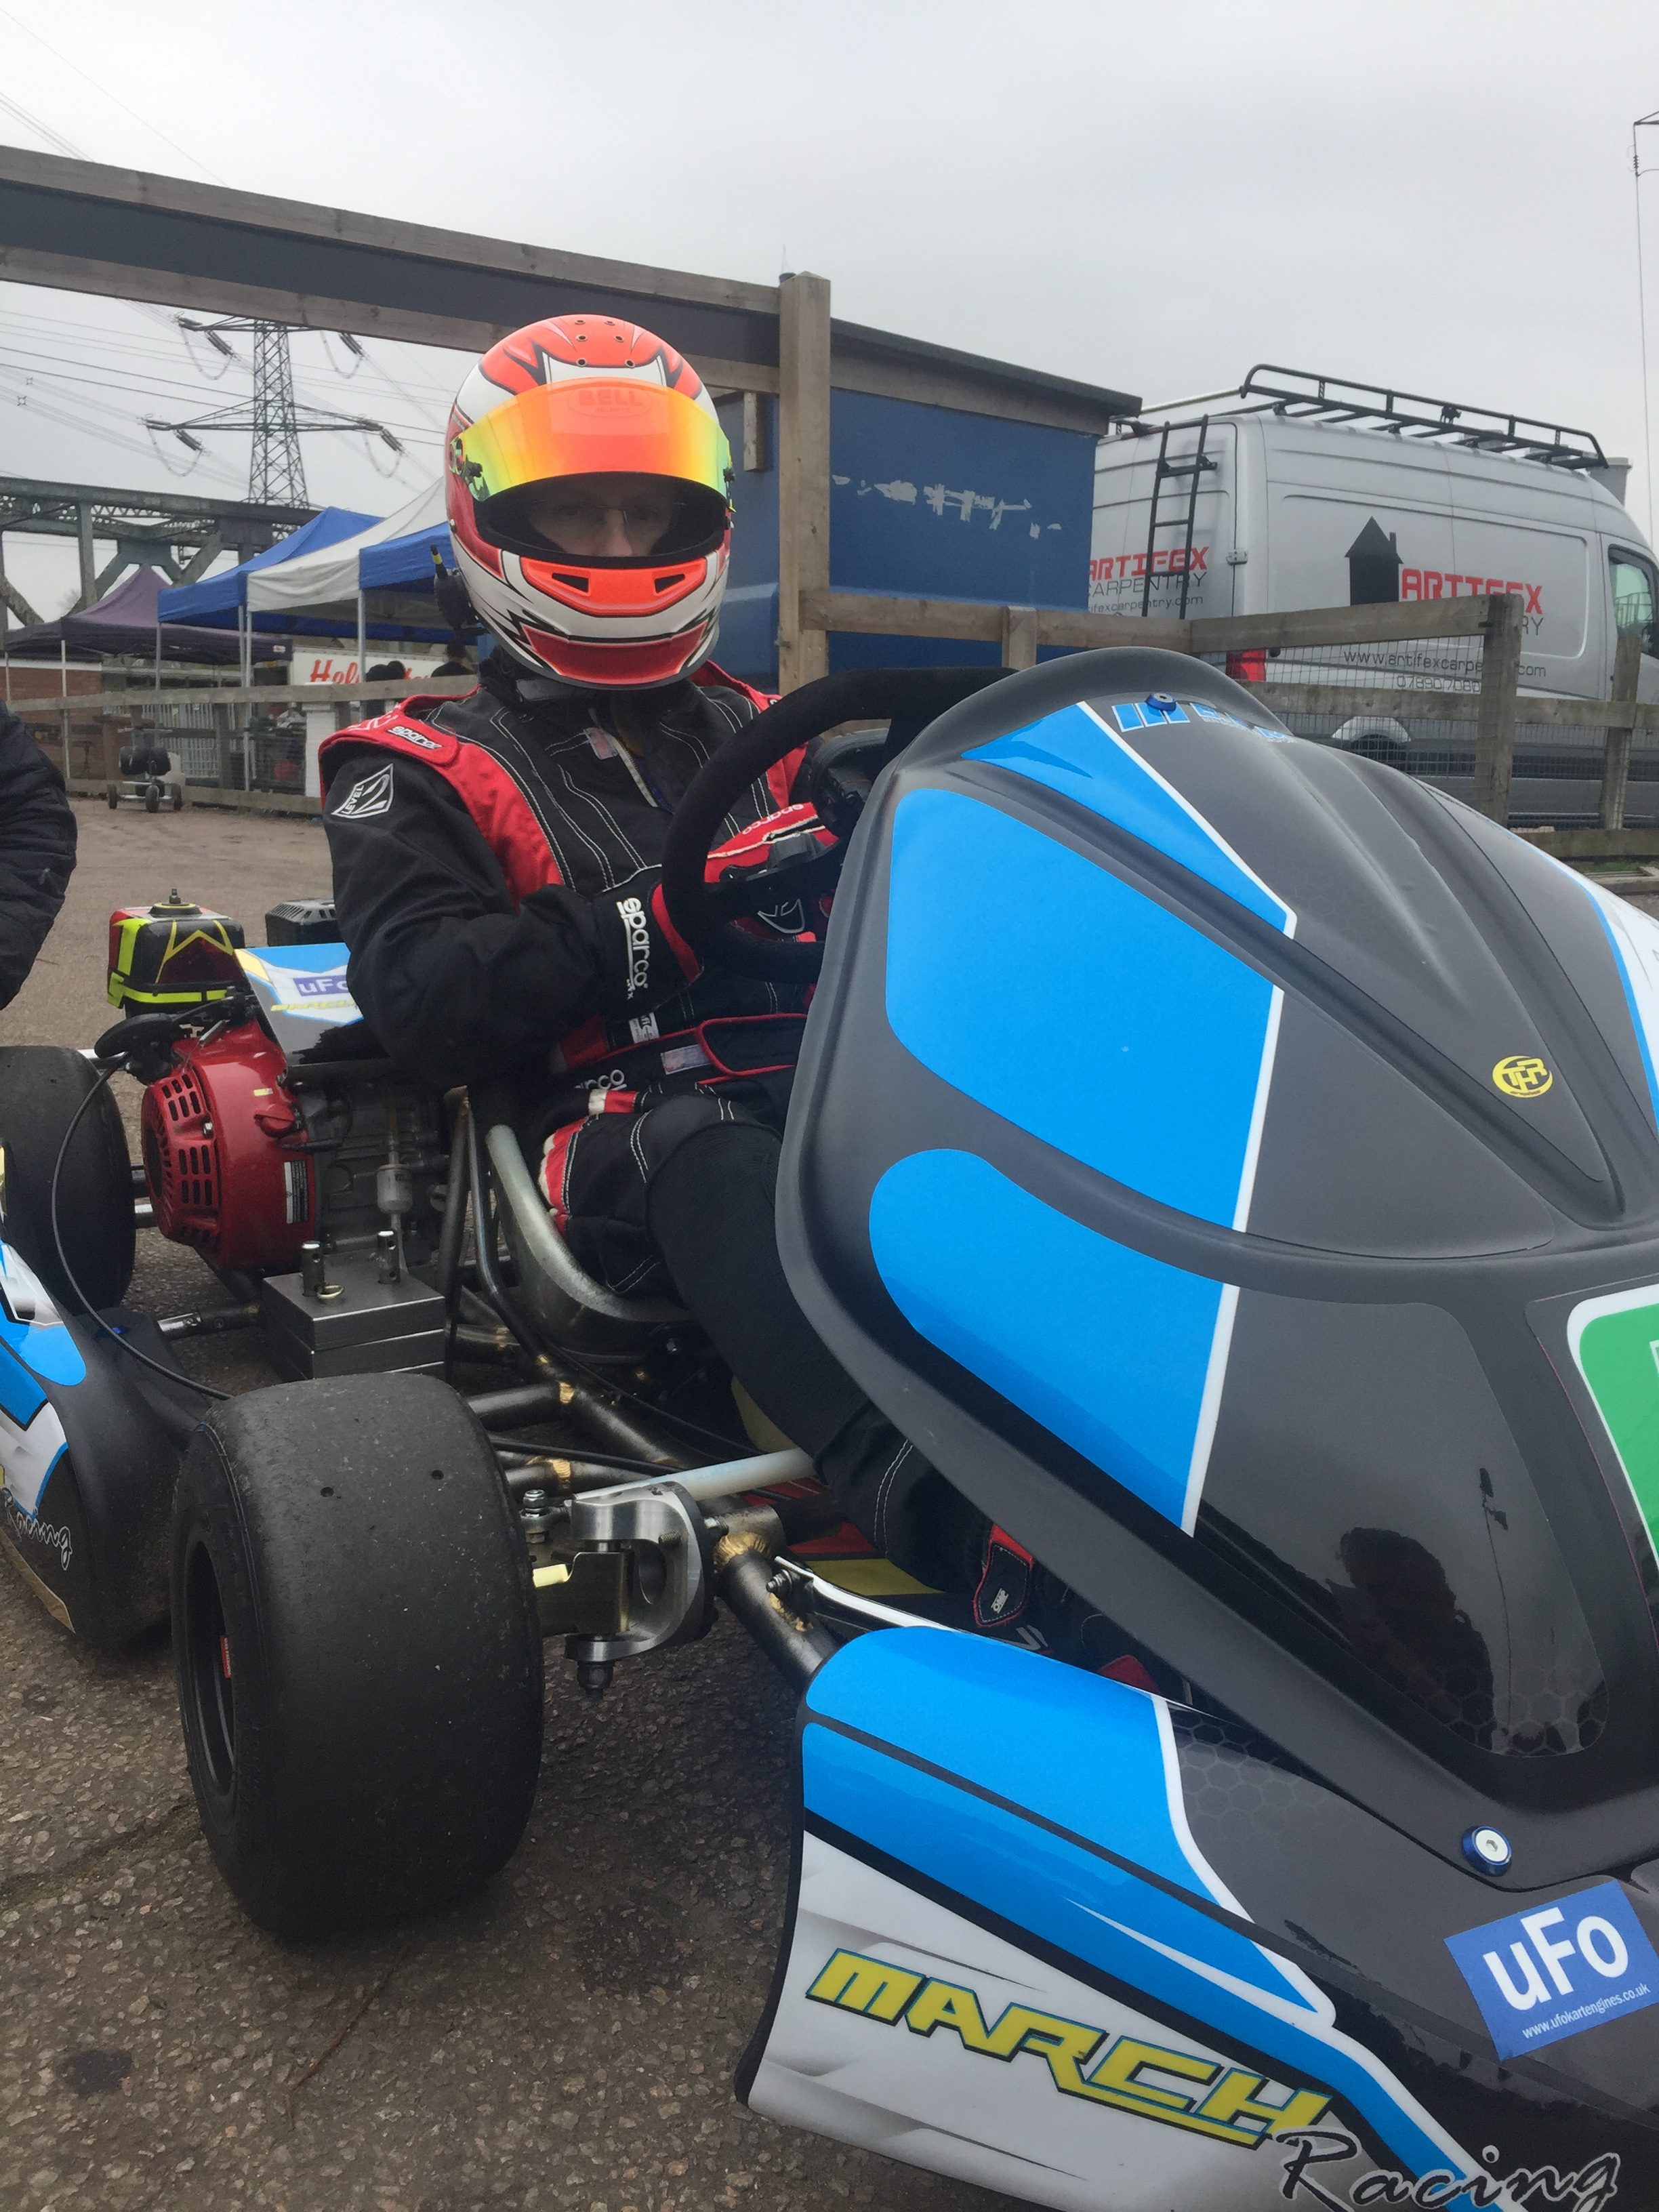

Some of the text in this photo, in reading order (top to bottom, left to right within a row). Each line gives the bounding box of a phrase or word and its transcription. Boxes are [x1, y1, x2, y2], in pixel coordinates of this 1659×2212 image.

[578, 389, 642, 407] BELL
[1088, 571, 1208, 598] ARPENTRY
[1089, 546, 1209, 581] ARTIFEX
[341, 784, 365, 815] LEVEL
[615, 897, 651, 991] sparco
[1522, 1982, 1651, 2039] www.ufokartengines.co.uk
[805, 1947, 1334, 2150] MARCH
[1271, 2125, 1622, 2212] Racing
